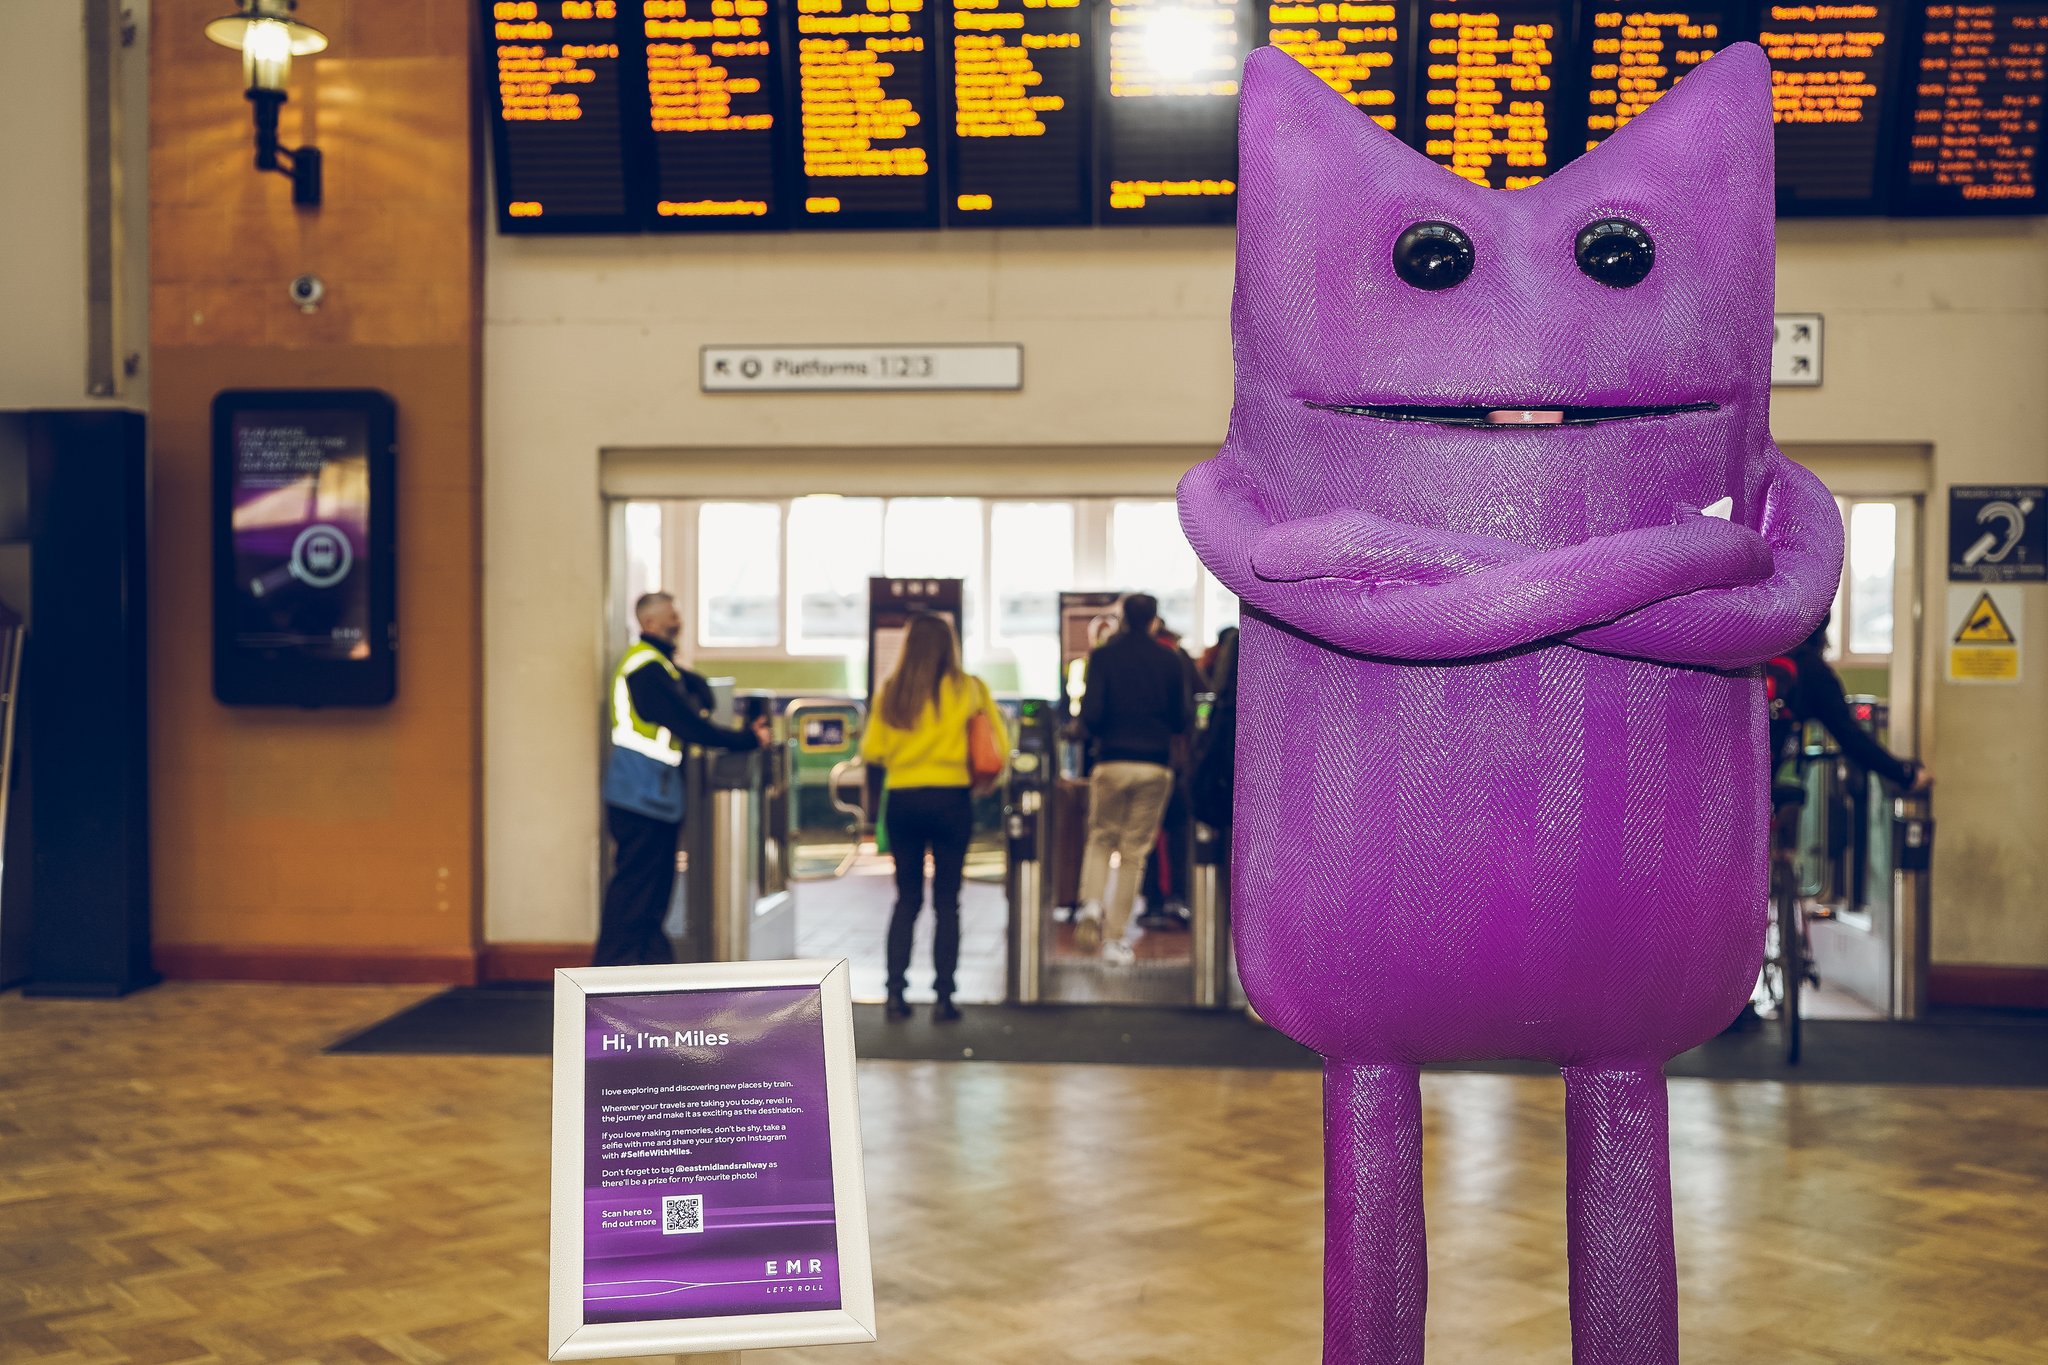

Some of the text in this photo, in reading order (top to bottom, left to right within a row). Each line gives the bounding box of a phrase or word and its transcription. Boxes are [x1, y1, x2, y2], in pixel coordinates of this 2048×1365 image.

[602, 1030, 729, 1052] Hi, I'm Miles
[623, 1086, 658, 1095] exploring
[676, 1083, 719, 1091] discovering
[738, 1082, 762, 1090] places
[763, 1081, 772, 1090] by
[601, 1104, 639, 1112] Wherever
[660, 1101, 686, 1109] travels
[741, 1098, 765, 1106] today,
[601, 1115, 615, 1123] the
[615, 1114, 646, 1123] journey
[663, 1111, 684, 1119] make
[702, 1109, 733, 1117] exciting
[642, 1129, 671, 1137] making
[672, 1127, 713, 1135] memories,
[715, 1125, 735, 1133] don't
[747, 1124, 762, 1133] shy,
[602, 1141, 623, 1149] selfie
[656, 1138, 671, 1146] and
[695, 1137, 713, 1145] your
[714, 1136, 735, 1144] story
[748, 1134, 787, 1142] Instagram
[621, 1148, 692, 1159] #SelfieWithMiles.
[602, 1169, 624, 1177] Don't
[625, 1168, 650, 1176] forget
[676, 1161, 767, 1172] @eastmidlandsrailway
[602, 1179, 629, 1187] there'll
[648, 1177, 667, 1186] prize
[682, 1176, 694, 1184] my
[695, 1173, 730, 1182] favourite
[732, 1172, 757, 1181] photo!
[602, 1210, 622, 1218] Scan
[602, 1220, 618, 1228] find
[765, 1259, 822, 1276] EMR
[767, 1284, 823, 1293] LET'S ROLL
